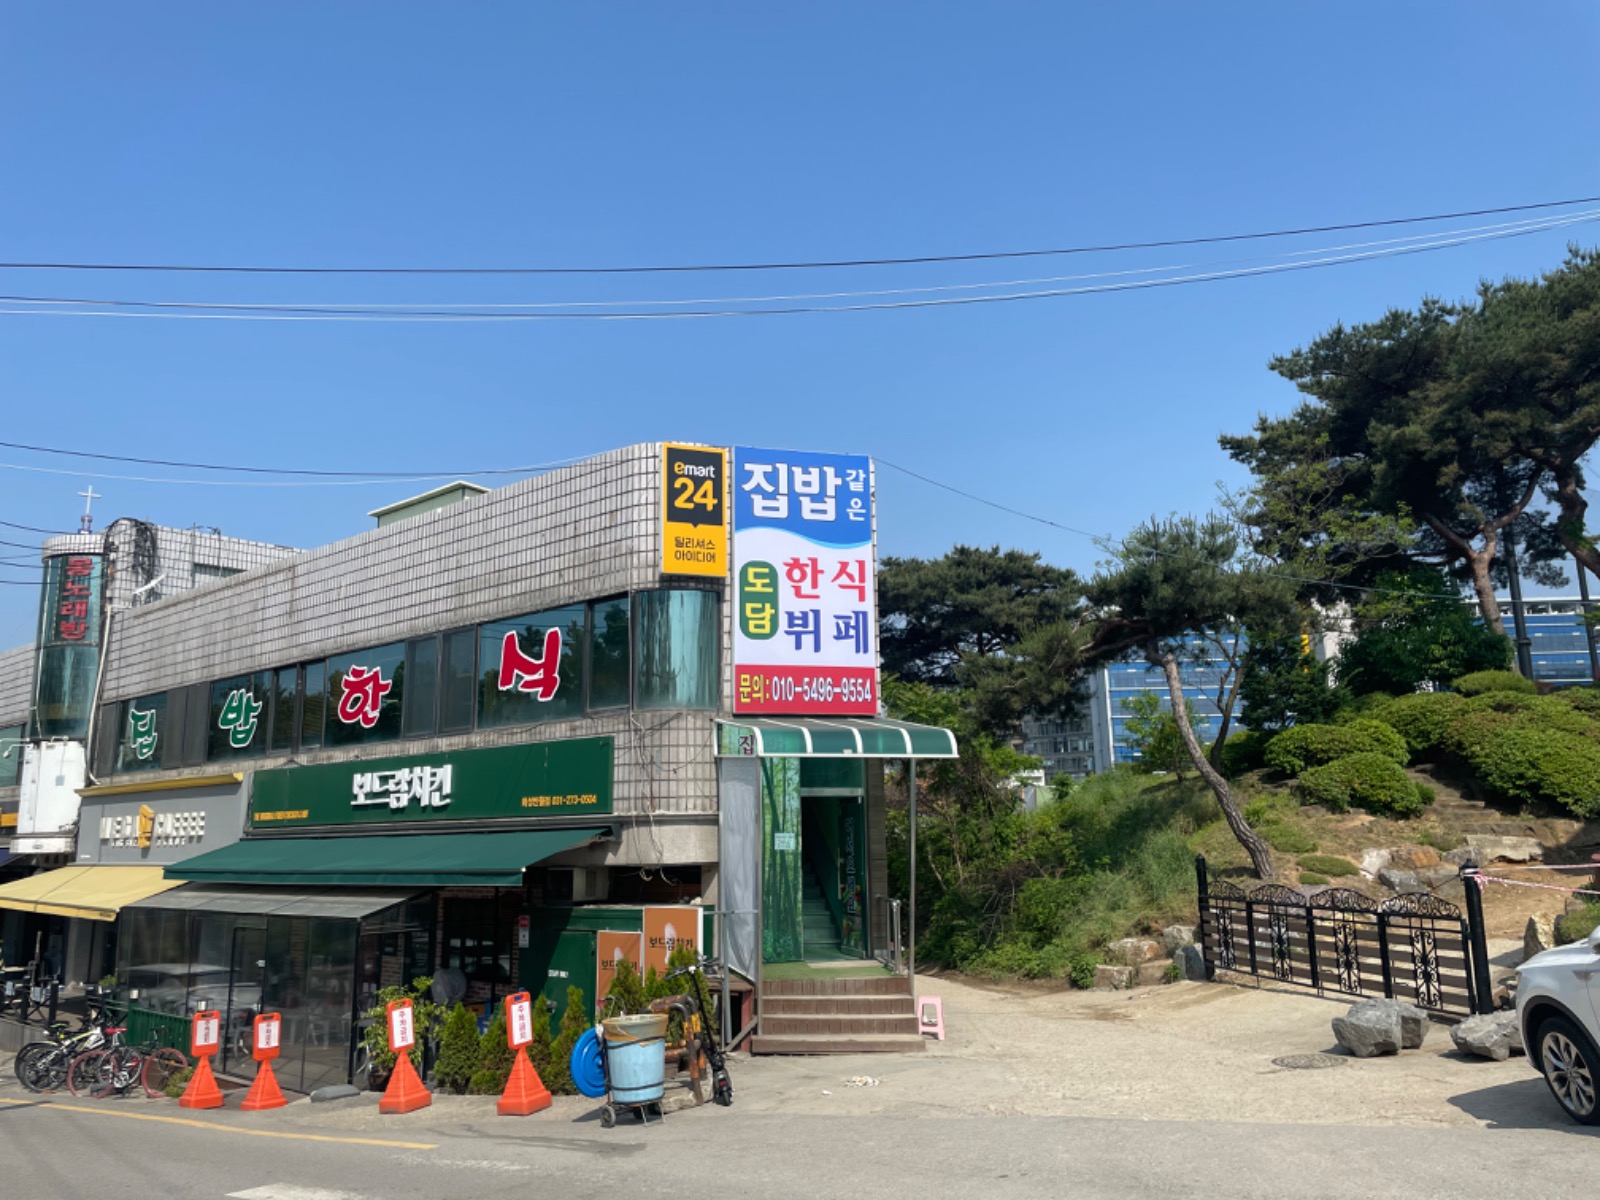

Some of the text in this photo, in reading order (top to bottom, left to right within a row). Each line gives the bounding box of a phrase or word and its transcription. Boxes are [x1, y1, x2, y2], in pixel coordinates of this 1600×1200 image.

[674, 461, 716, 478] emart
[741, 463, 842, 522] 집밥
[674, 477, 718, 512] 24
[845, 469, 867, 522] 같은
[674, 536, 716, 551] 딜리셔스
[674, 550, 716, 564] 아이디어
[744, 566, 776, 635] 도담
[783, 556, 867, 603] 한식
[784, 608, 869, 655] 뷔페
[350, 764, 452, 809] 보드람치킨
